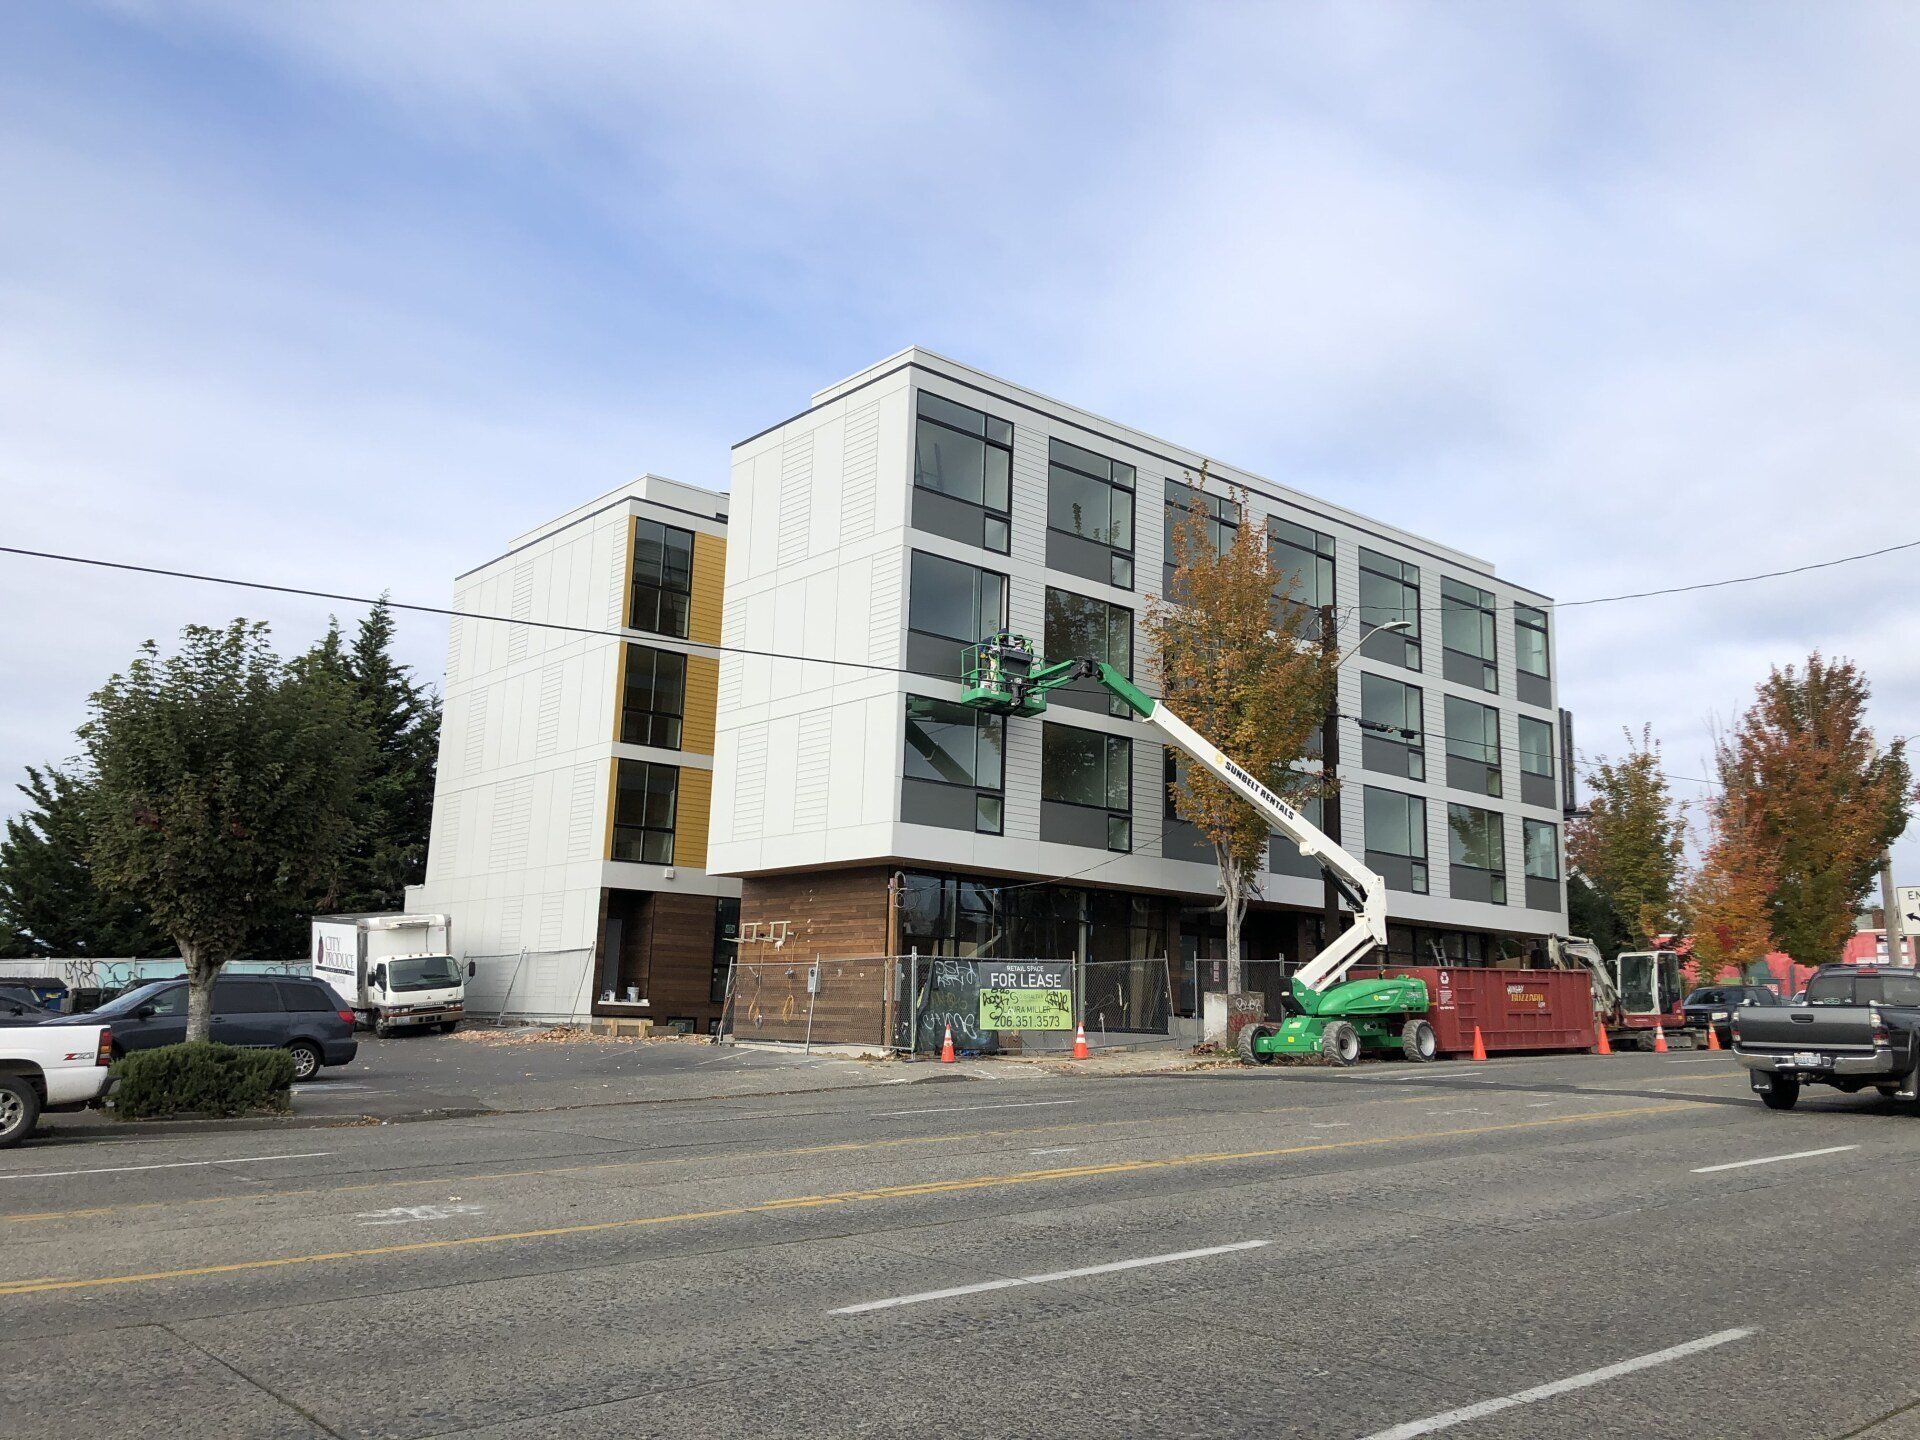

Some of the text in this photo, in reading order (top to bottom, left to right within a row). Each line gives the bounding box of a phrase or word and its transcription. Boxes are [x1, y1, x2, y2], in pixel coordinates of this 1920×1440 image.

[1225, 761, 1294, 820] SUNBELT RENTALS
[325, 936, 341, 951] CITY
[325, 951, 354, 969] PRODUCE
[990, 973, 1061, 988] FOR LEASE
[1026, 1006, 1051, 1014] MILLER
[994, 1015, 1060, 1028] 206.351.3573
